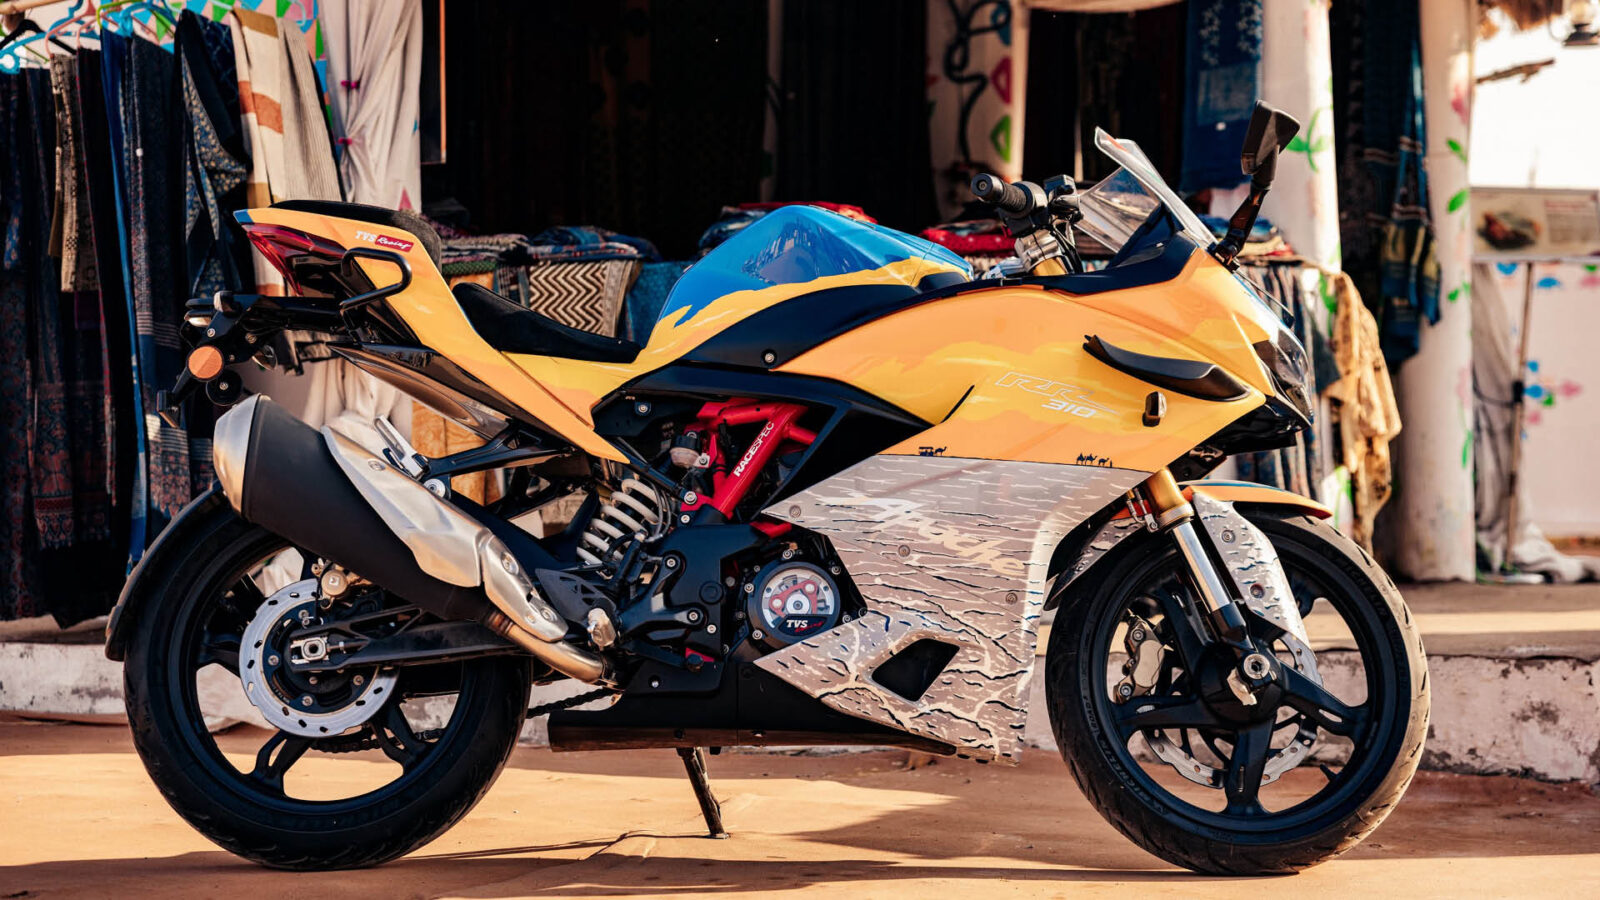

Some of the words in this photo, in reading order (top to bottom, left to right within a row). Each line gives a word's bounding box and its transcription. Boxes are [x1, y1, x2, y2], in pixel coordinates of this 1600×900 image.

[355, 230, 377, 243] TVS
[378, 237, 412, 249] Racing
[1040, 398, 1097, 418] 310
[733, 421, 774, 477] RACESPEC
[816, 494, 1028, 577] Apache
[786, 619, 808, 628] TVS
